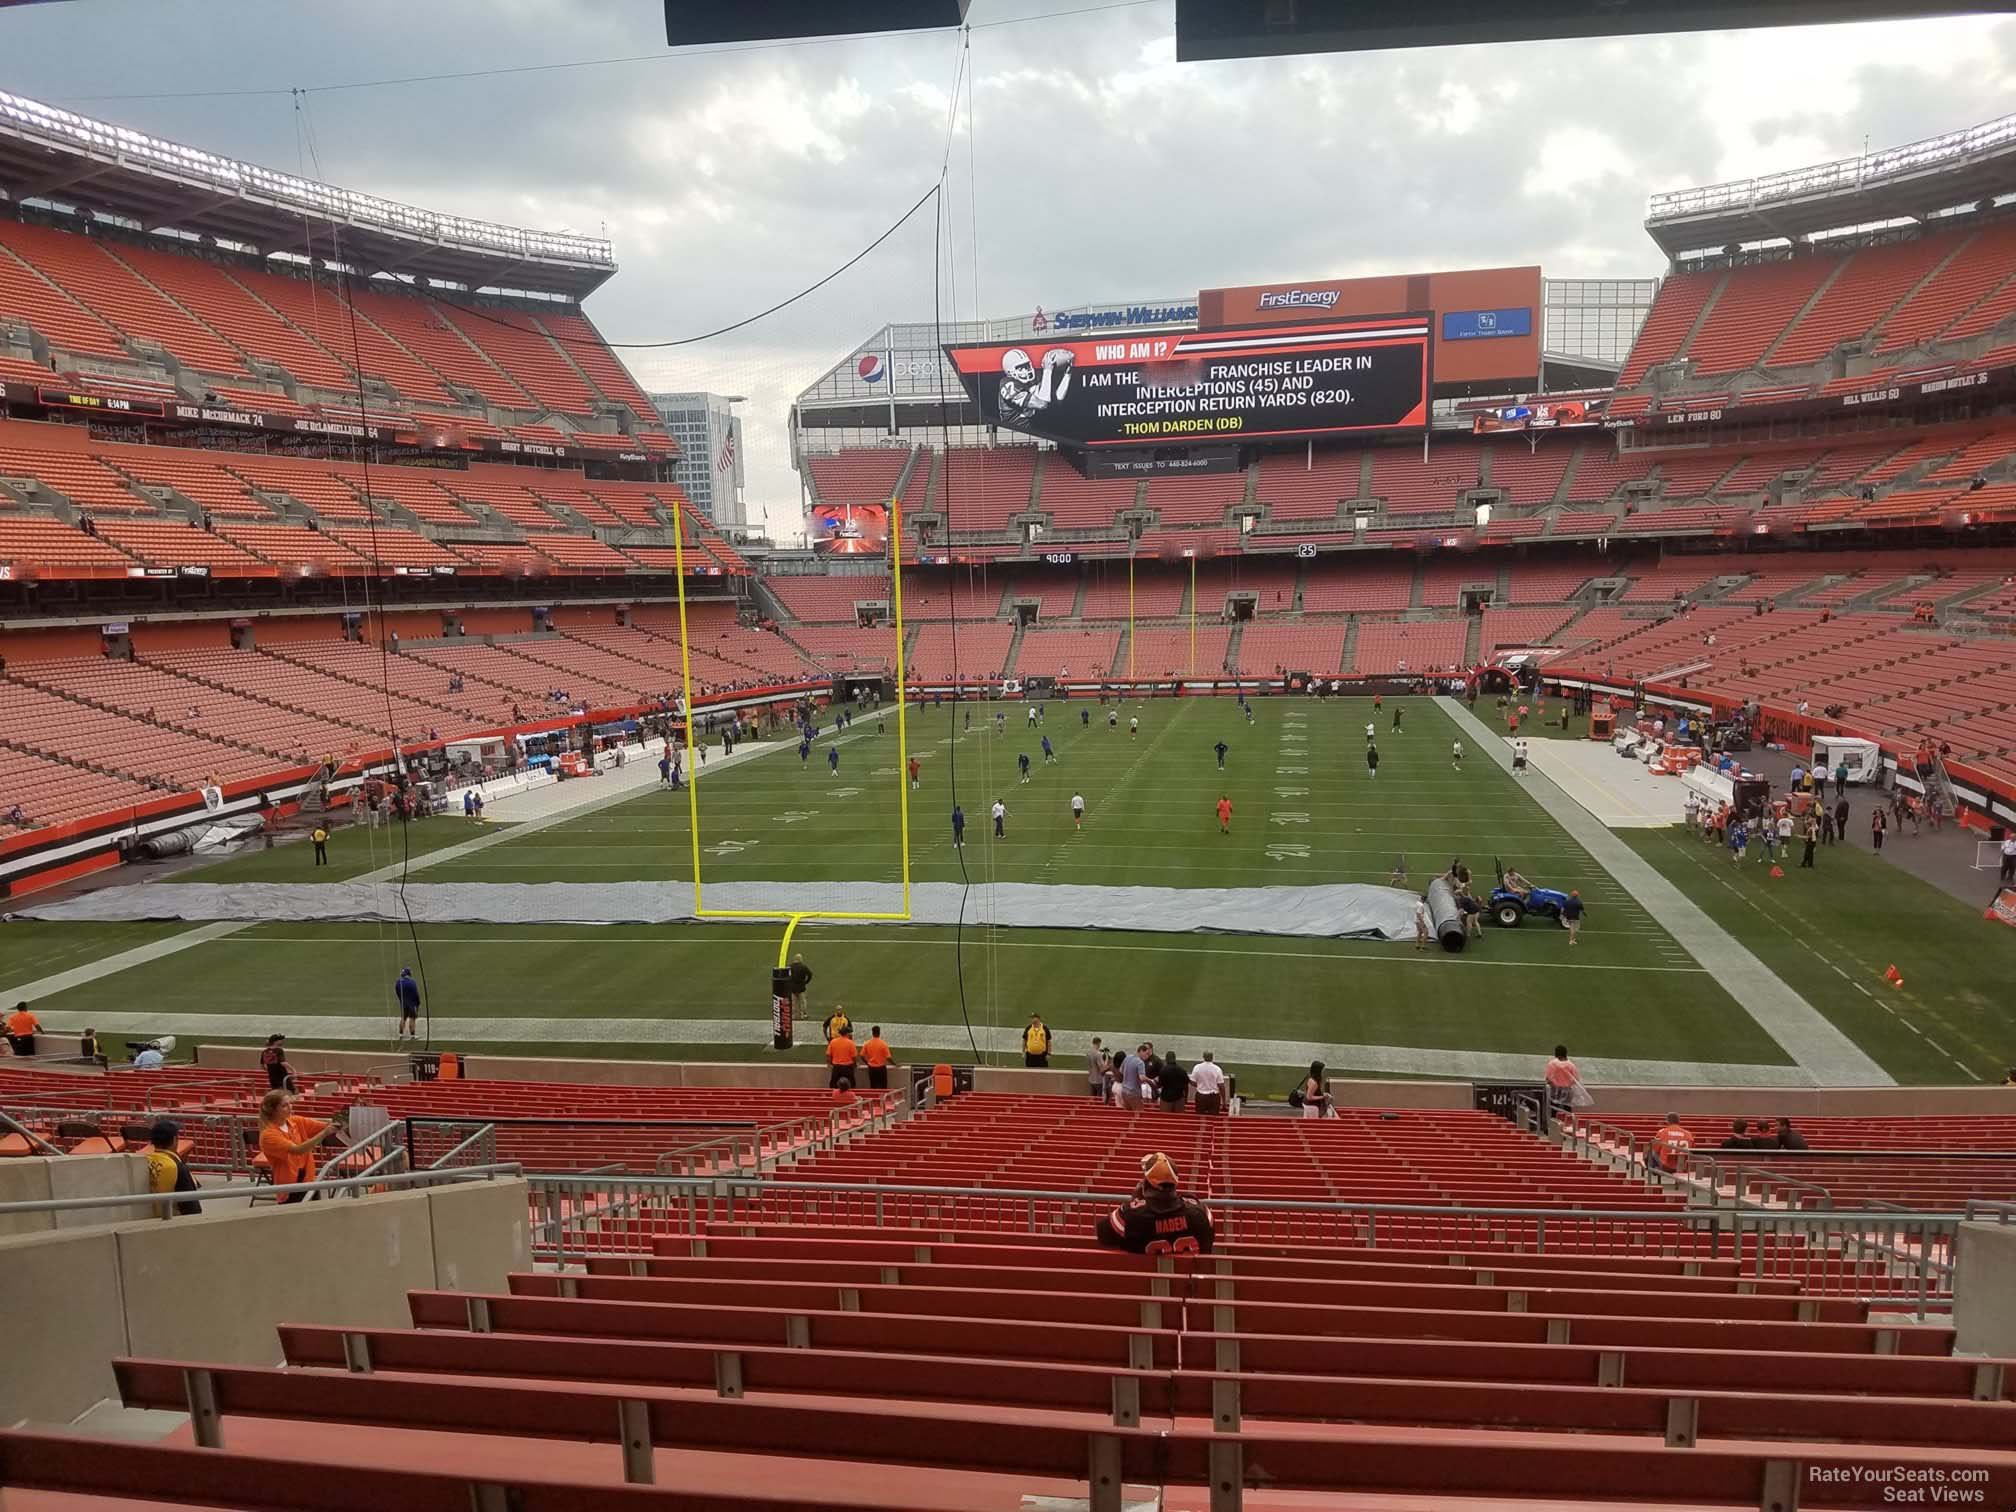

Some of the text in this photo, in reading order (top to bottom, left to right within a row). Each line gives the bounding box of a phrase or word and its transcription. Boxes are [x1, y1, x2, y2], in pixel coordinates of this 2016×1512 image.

[1260, 290, 1341, 306] FirstEnergy
[1095, 341, 1167, 361] WHO AM I?
[1082, 355, 1373, 387] I AM THE FRANCHISE LEADER IN
[1136, 376, 1314, 400] INTERCEPTIONS (45) AND
[1098, 389, 1356, 417] INTERCEPTION RETURN YARDS (820).
[1861, 391, 1887, 403] WILLIS
[120, 400, 130, 411] PM
[176, 406, 199, 418] MIKE
[252, 414, 264, 427] 74
[1667, 414, 1685, 424] LEN
[1688, 412, 1709, 423] FORD
[294, 419, 309, 430] JOE
[1124, 421, 1160, 436] THOM
[1162, 418, 1214, 433] DARDEN
[1216, 416, 1243, 432] (DB)
[1114, 463, 1130, 471] TEXT
[1156, 461, 1166, 469] TO
[1302, 545, 1315, 556] 25
[1046, 553, 1072, 564] 90:00
